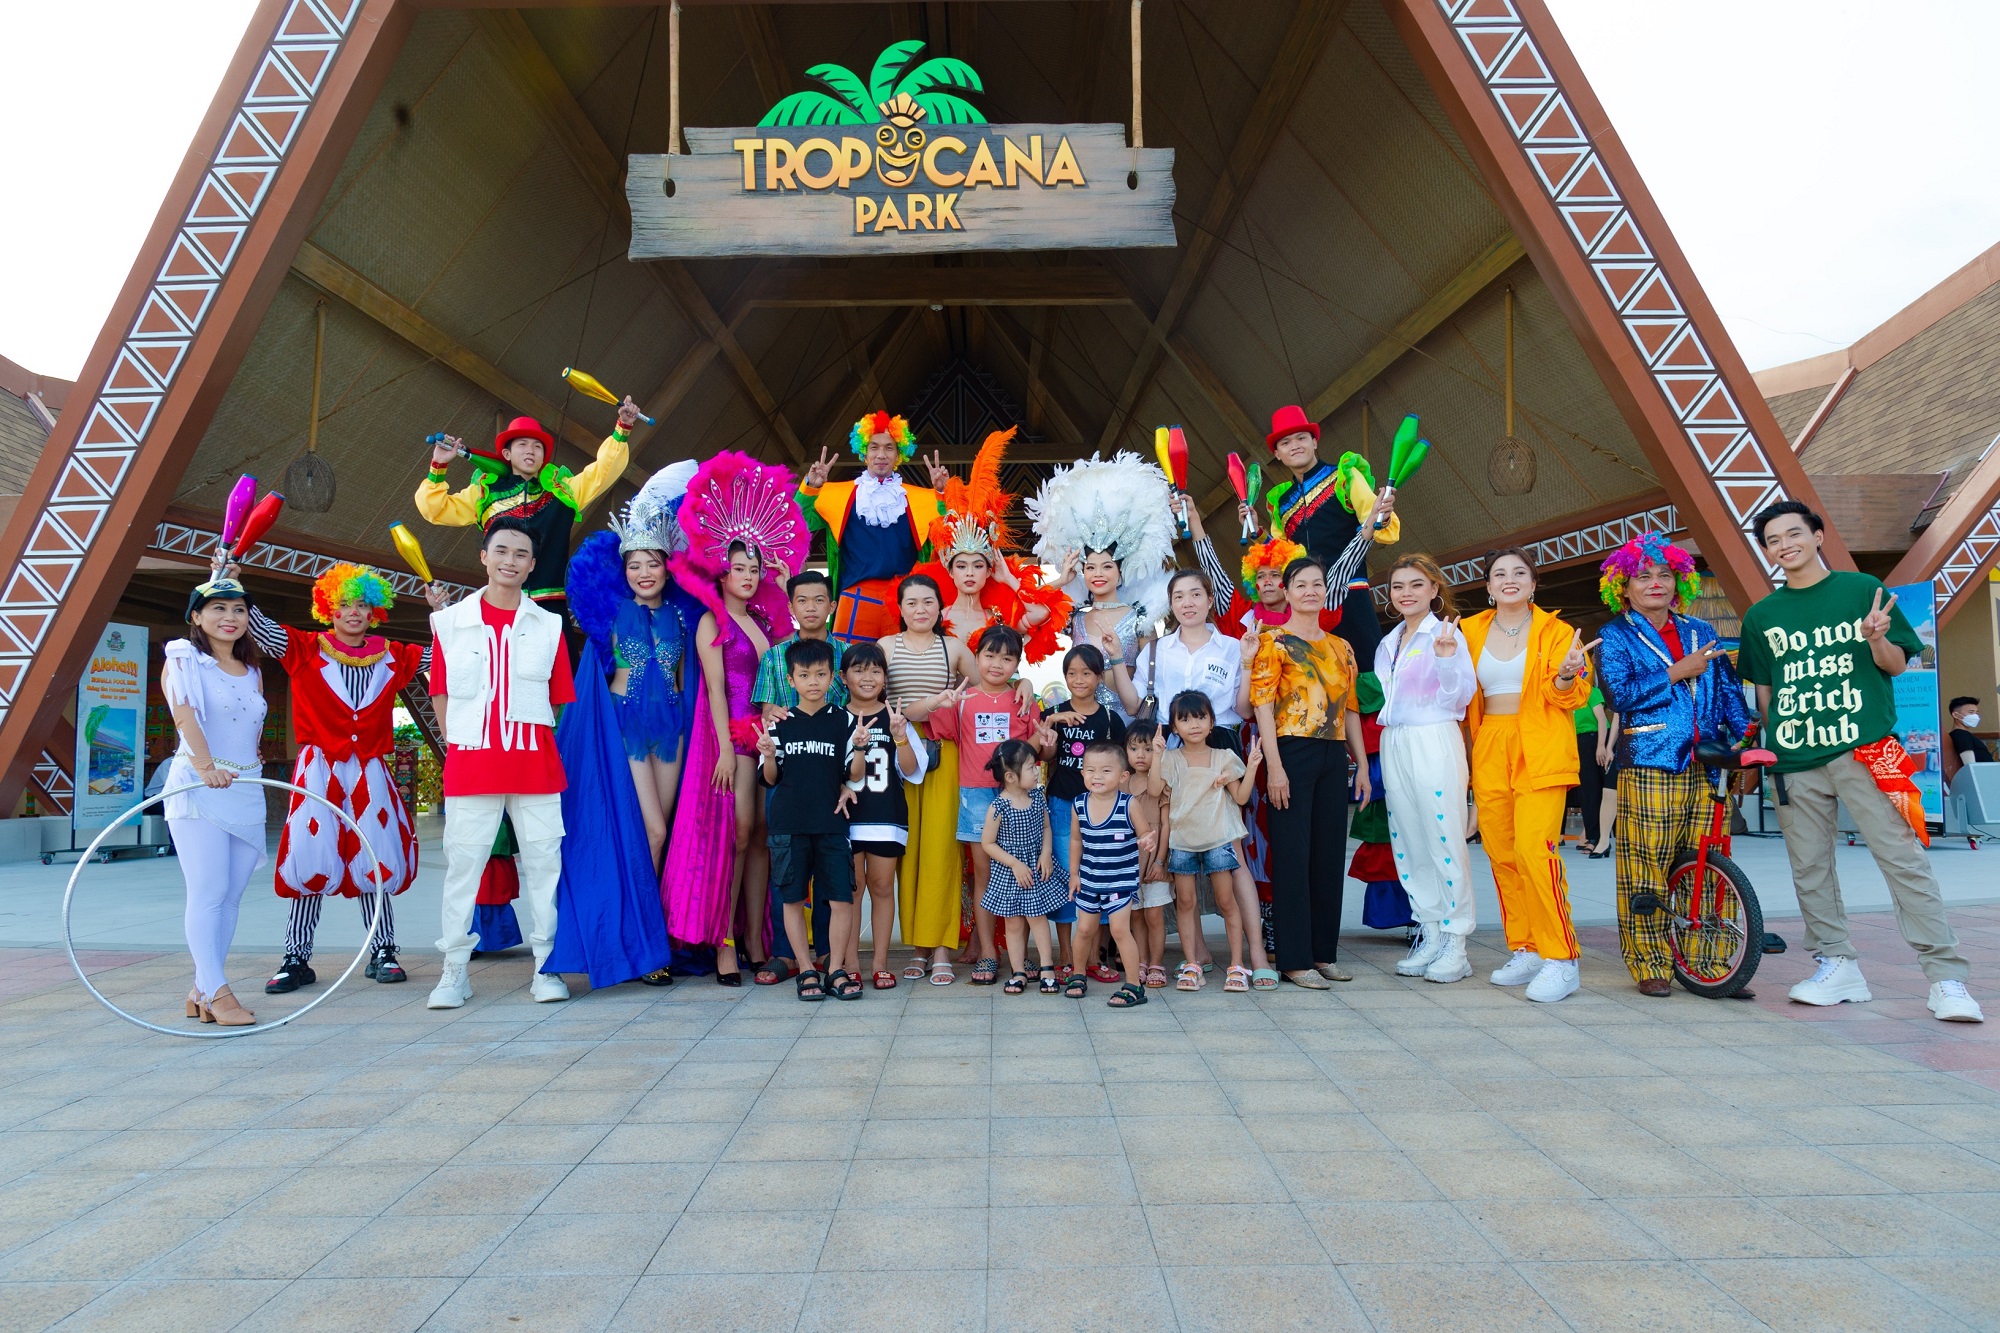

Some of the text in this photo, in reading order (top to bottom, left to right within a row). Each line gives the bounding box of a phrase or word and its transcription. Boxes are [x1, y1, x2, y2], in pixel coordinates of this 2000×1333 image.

[855, 193, 962, 234] PARK
[1763, 617, 1867, 661] Do not
[90, 656, 139, 677] Aloha!!!
[1208, 664, 1228, 679] WITH
[1783, 649, 1854, 683] miss
[869, 734, 891, 743] EIGHTS
[1776, 714, 1859, 750] Club
[785, 740, 836, 757] OFF-WHITE
